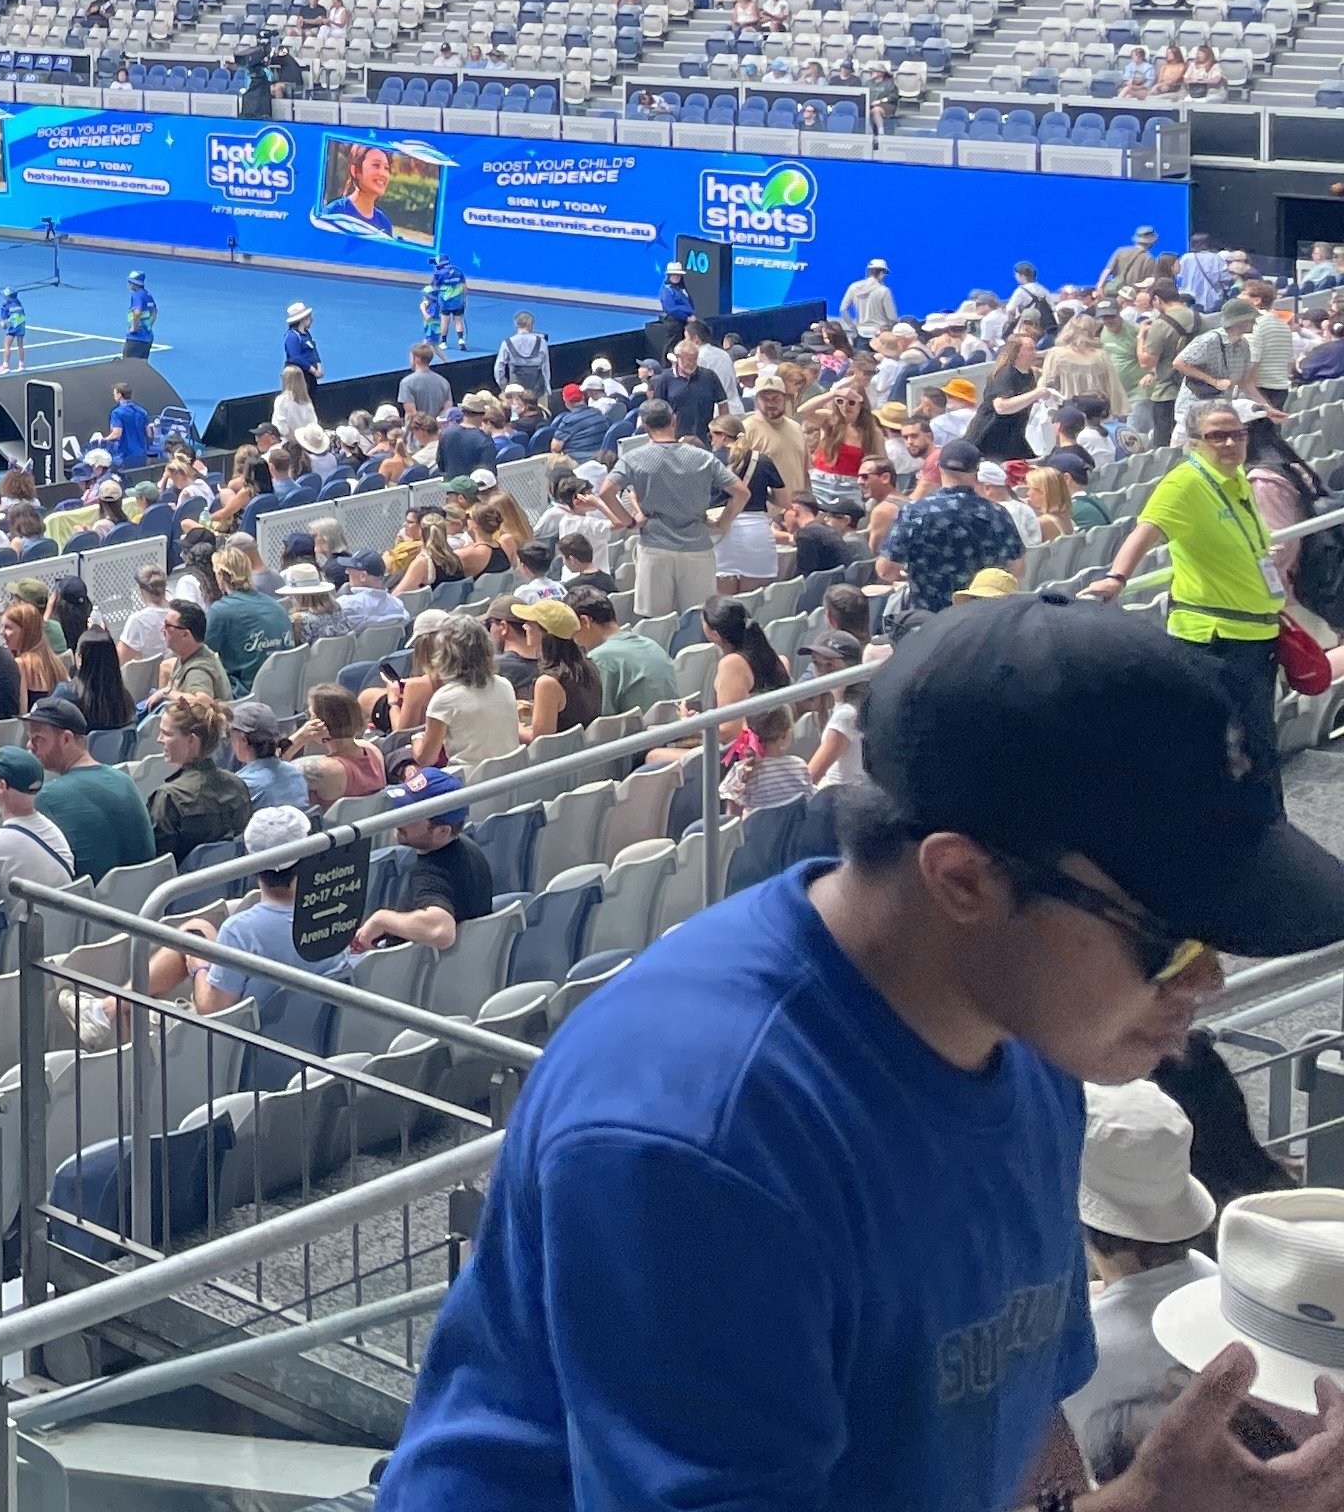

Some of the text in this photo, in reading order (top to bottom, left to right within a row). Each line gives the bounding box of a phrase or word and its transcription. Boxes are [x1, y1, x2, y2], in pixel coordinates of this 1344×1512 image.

[37, 122, 154, 138] BOOST YOUR CHILD'S
[48, 133, 141, 149] CONFIDENCE
[211, 138, 255, 164] hot
[56, 157, 133, 172] SIGN UP TODAY
[482, 157, 636, 173] BOOST YOUR CHILD'S
[27, 171, 166, 192] hotshots.tennis.com.au
[211, 161, 289, 188] shots
[496, 169, 619, 186] CONFIDENCE
[229, 184, 273, 199] tennis
[707, 176, 764, 205] hot
[233, 207, 290, 220] DIFFERENT
[507, 196, 608, 214] SIGN UP TODAY
[468, 211, 650, 237] hotshots.tennis.com.au
[706, 202, 809, 234] shots
[729, 230, 786, 246] tennis
[734, 256, 809, 271] DIFFERENT
[313, 864, 355, 886] Sections
[302, 877, 361, 908] 20-17 47-44
[300, 918, 358, 946] Arena Floor
